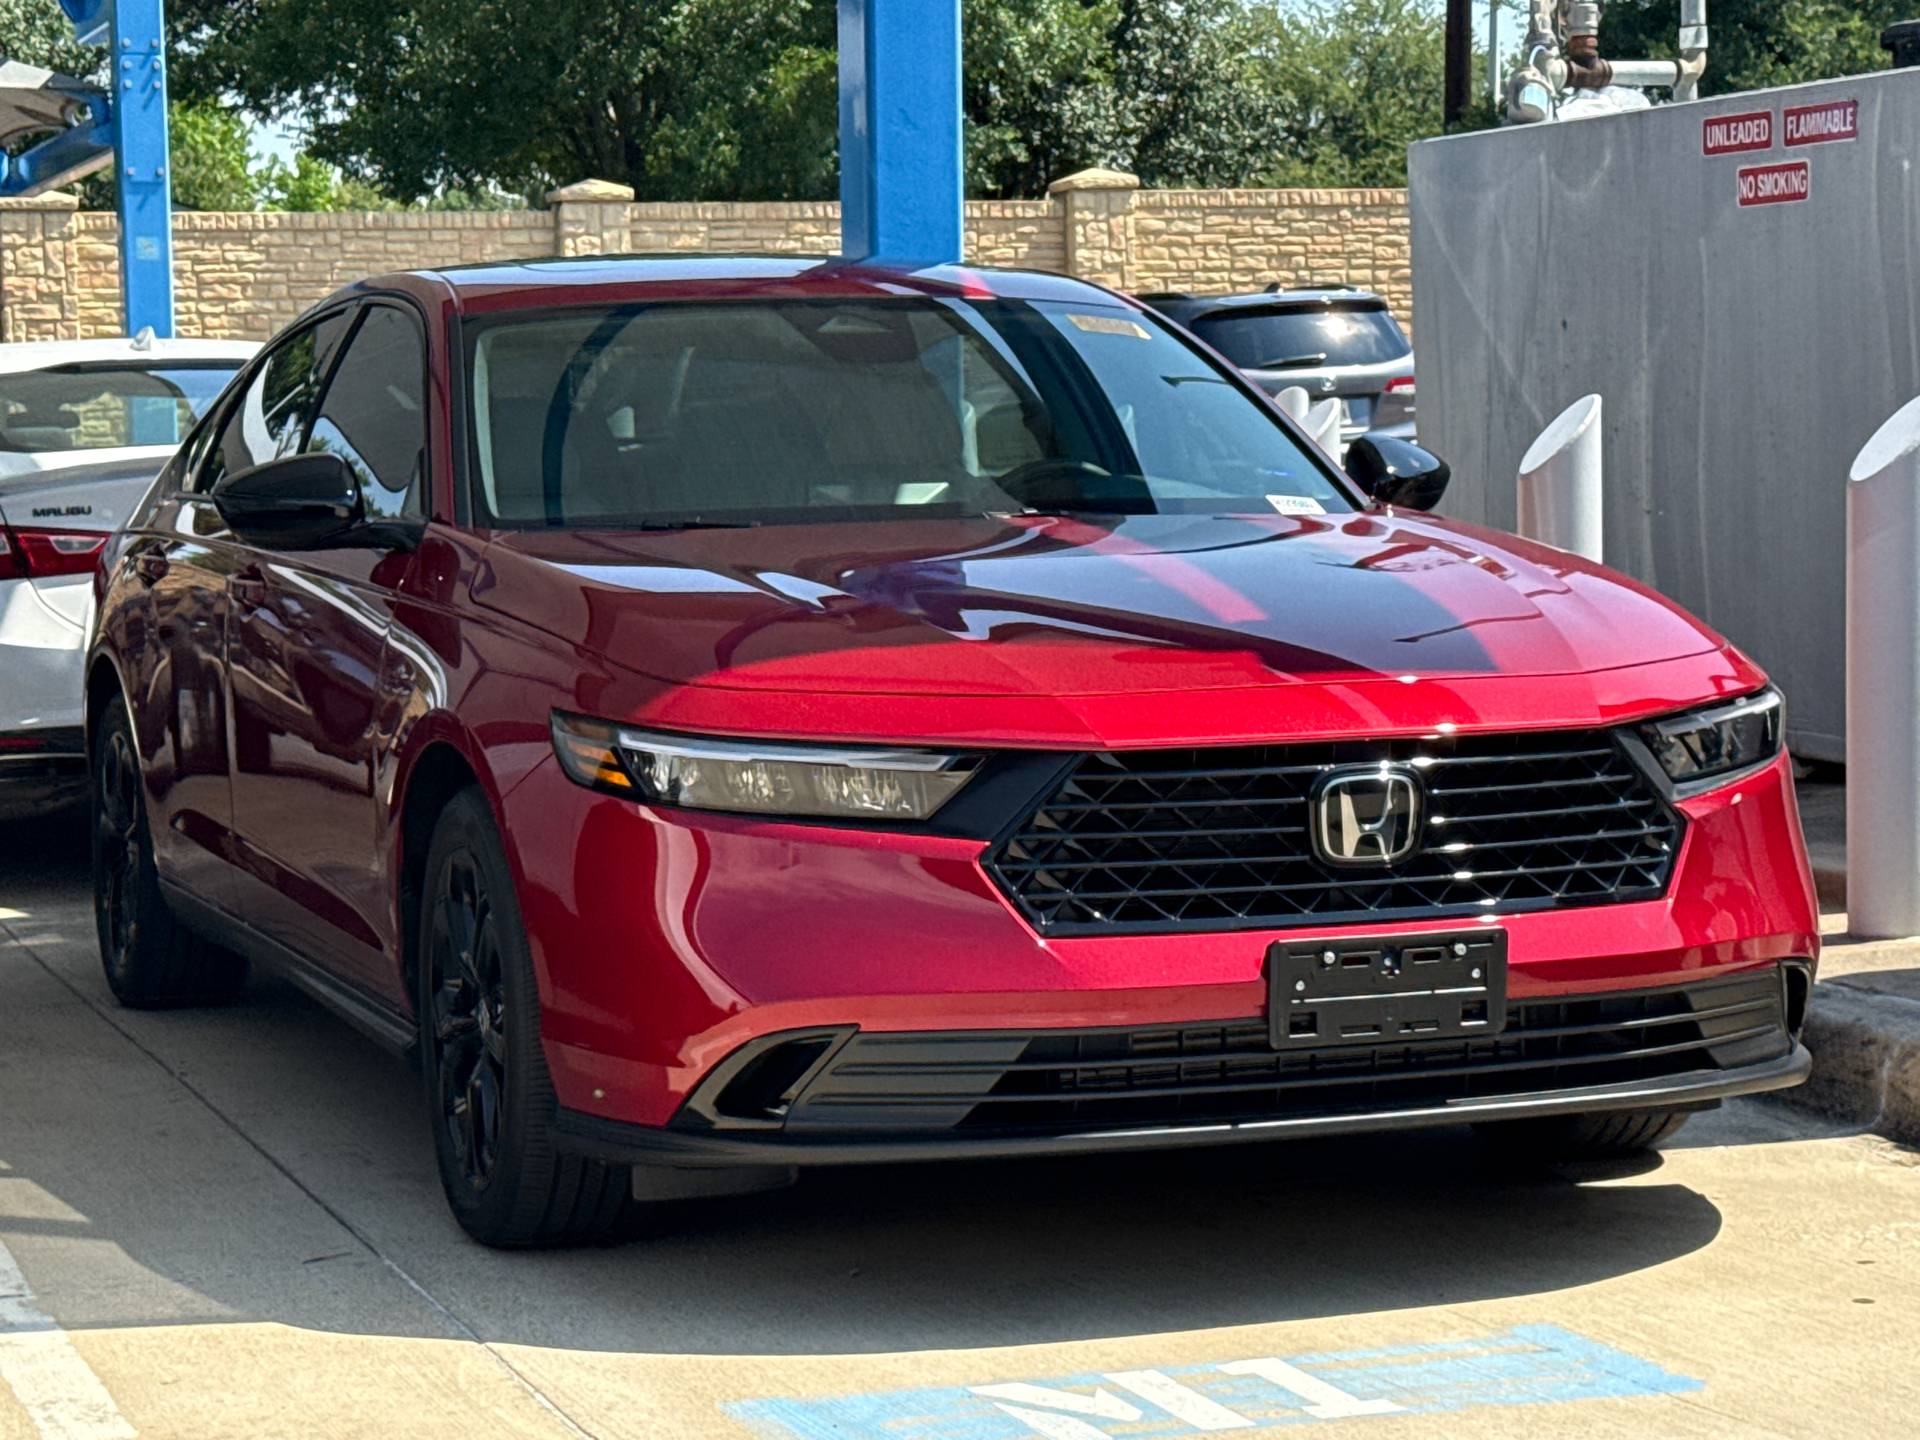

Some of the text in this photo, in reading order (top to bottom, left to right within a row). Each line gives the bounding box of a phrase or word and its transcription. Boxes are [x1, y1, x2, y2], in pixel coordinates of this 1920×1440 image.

[1706, 118, 1769, 148] UNLEADED
[1786, 107, 1854, 140] FLAMMABLE
[1739, 168, 1807, 199] NO SMOKING
[32, 505, 92, 518] MALIBU
[967, 1356, 1407, 1440] M1
